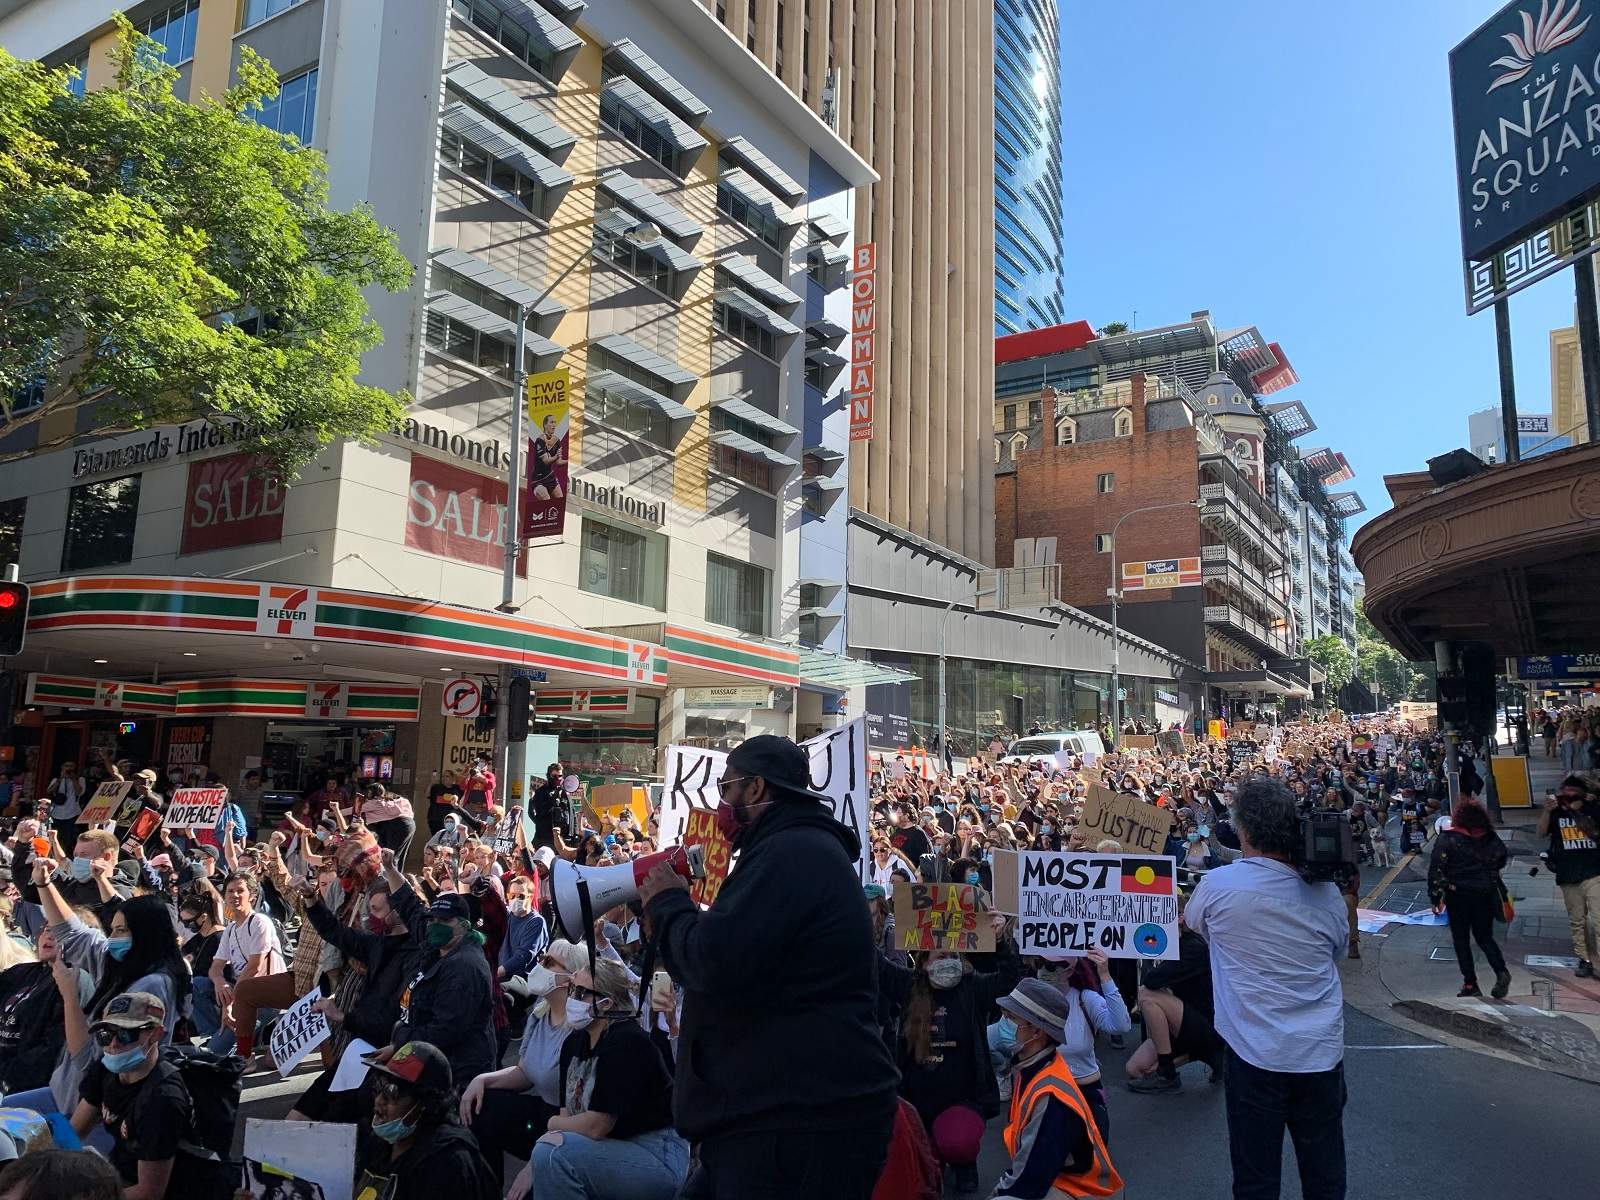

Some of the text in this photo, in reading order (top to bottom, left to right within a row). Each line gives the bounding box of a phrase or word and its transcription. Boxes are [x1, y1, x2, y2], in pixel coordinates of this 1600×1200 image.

[1521, 62, 1560, 95] THE
[1471, 52, 1600, 175] ANZA
[854, 248, 873, 420] BOWMAN
[532, 380, 565, 395] TWO
[532, 391, 566, 407] TIME
[389, 417, 512, 472] amonds
[851, 429, 872, 438] HOUSE
[72, 431, 170, 479] Diamonds
[191, 472, 286, 528] SALE
[569, 474, 666, 526] rnational
[1149, 576, 1175, 585] XXXX
[270, 586, 308, 634] 7
[633, 643, 649, 680] 7
[174, 789, 225, 805] NO JUSTICE
[168, 806, 218, 823] NO PEACE
[687, 813, 725, 840] BLA
[1085, 808, 1163, 853] JUSTICE
[1559, 818, 1577, 828] BLA
[1022, 855, 1121, 890] MOST
[912, 885, 989, 913] BLACK
[1022, 890, 1177, 924] INCARCERATED
[917, 910, 977, 930] LIVES
[1022, 921, 1126, 950] PEOPLE ON
[904, 928, 979, 950] MATTER
[275, 1018, 325, 1067] MATTER
